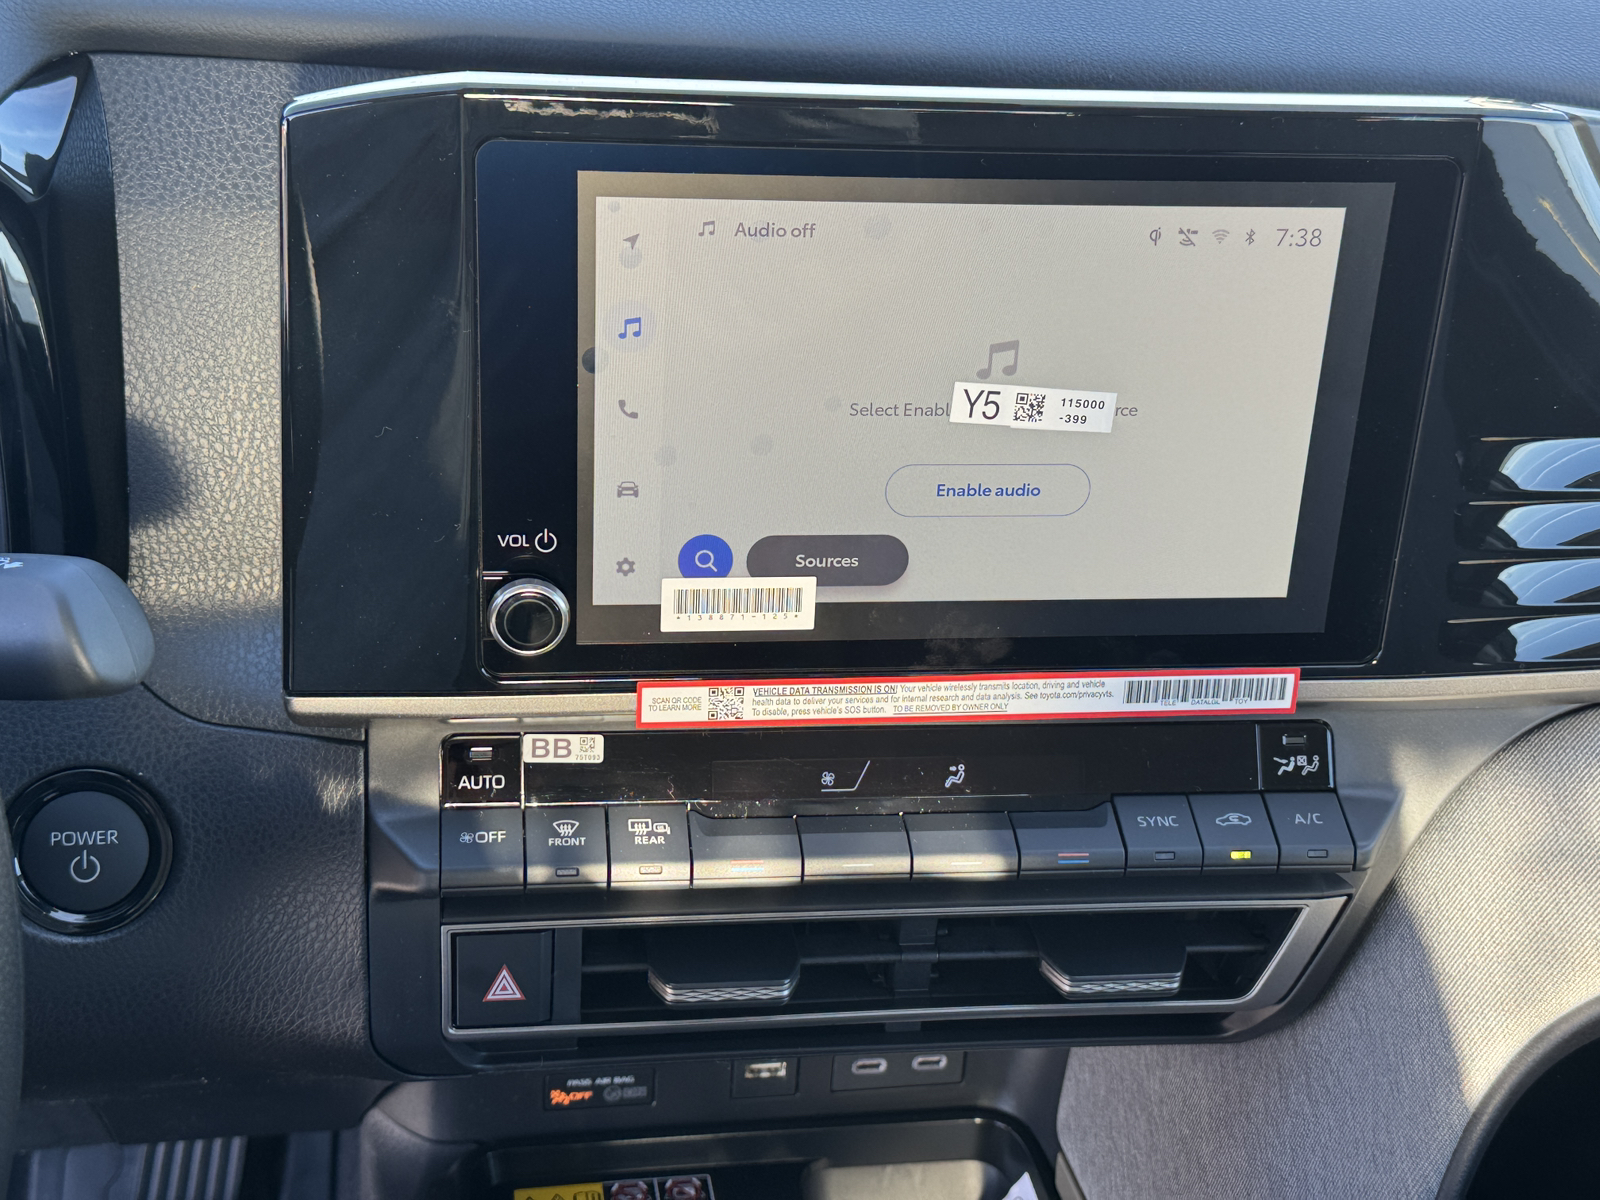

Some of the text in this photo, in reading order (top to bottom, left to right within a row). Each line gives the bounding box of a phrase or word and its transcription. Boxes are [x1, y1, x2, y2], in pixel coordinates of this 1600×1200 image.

[734, 222, 816, 238] Audio off
[1276, 228, 1322, 247] 7:38
[849, 402, 900, 417] Select
[903, 402, 950, 417] Enabl
[963, 389, 1001, 421] Y5
[1061, 398, 1105, 410] 115000
[1059, 414, 1087, 424] -399
[936, 483, 1041, 497] Enable audio
[497, 534, 530, 547] VOL
[795, 554, 859, 568] Sources
[753, 680, 1106, 697] VEHICLE DATA TRANSMISSION IS ON! Your vehicle wirelessly transmits location, driving and vehicle
[652, 697, 671, 705] SCAN
[683, 696, 702, 704] CODE
[752, 698, 774, 706] health
[775, 697, 791, 705] data
[802, 697, 826, 705] deliver
[827, 697, 843, 706] your
[845, 696, 874, 704] services
[875, 695, 889, 703] and
[891, 695, 900, 703] for
[902, 694, 928, 702] internal
[929, 693, 960, 702] research
[961, 693, 974, 701] and
[976, 693, 991, 701] data
[992, 691, 1023, 701] analysis.
[1024, 691, 1038, 699] See
[648, 704, 658, 712] TO
[752, 702, 1009, 717] To disable, press vehicle's SOS button. TO BE REMOVED BY OWNER ONLY
[531, 738, 572, 758] BB
[458, 775, 505, 789] AUTO
[1137, 816, 1179, 827] SYNC
[1294, 813, 1323, 824] A/C
[51, 830, 119, 846] POWER
[475, 831, 506, 843] OFF
[548, 836, 586, 846] FRONT
[634, 836, 665, 845] REAR
